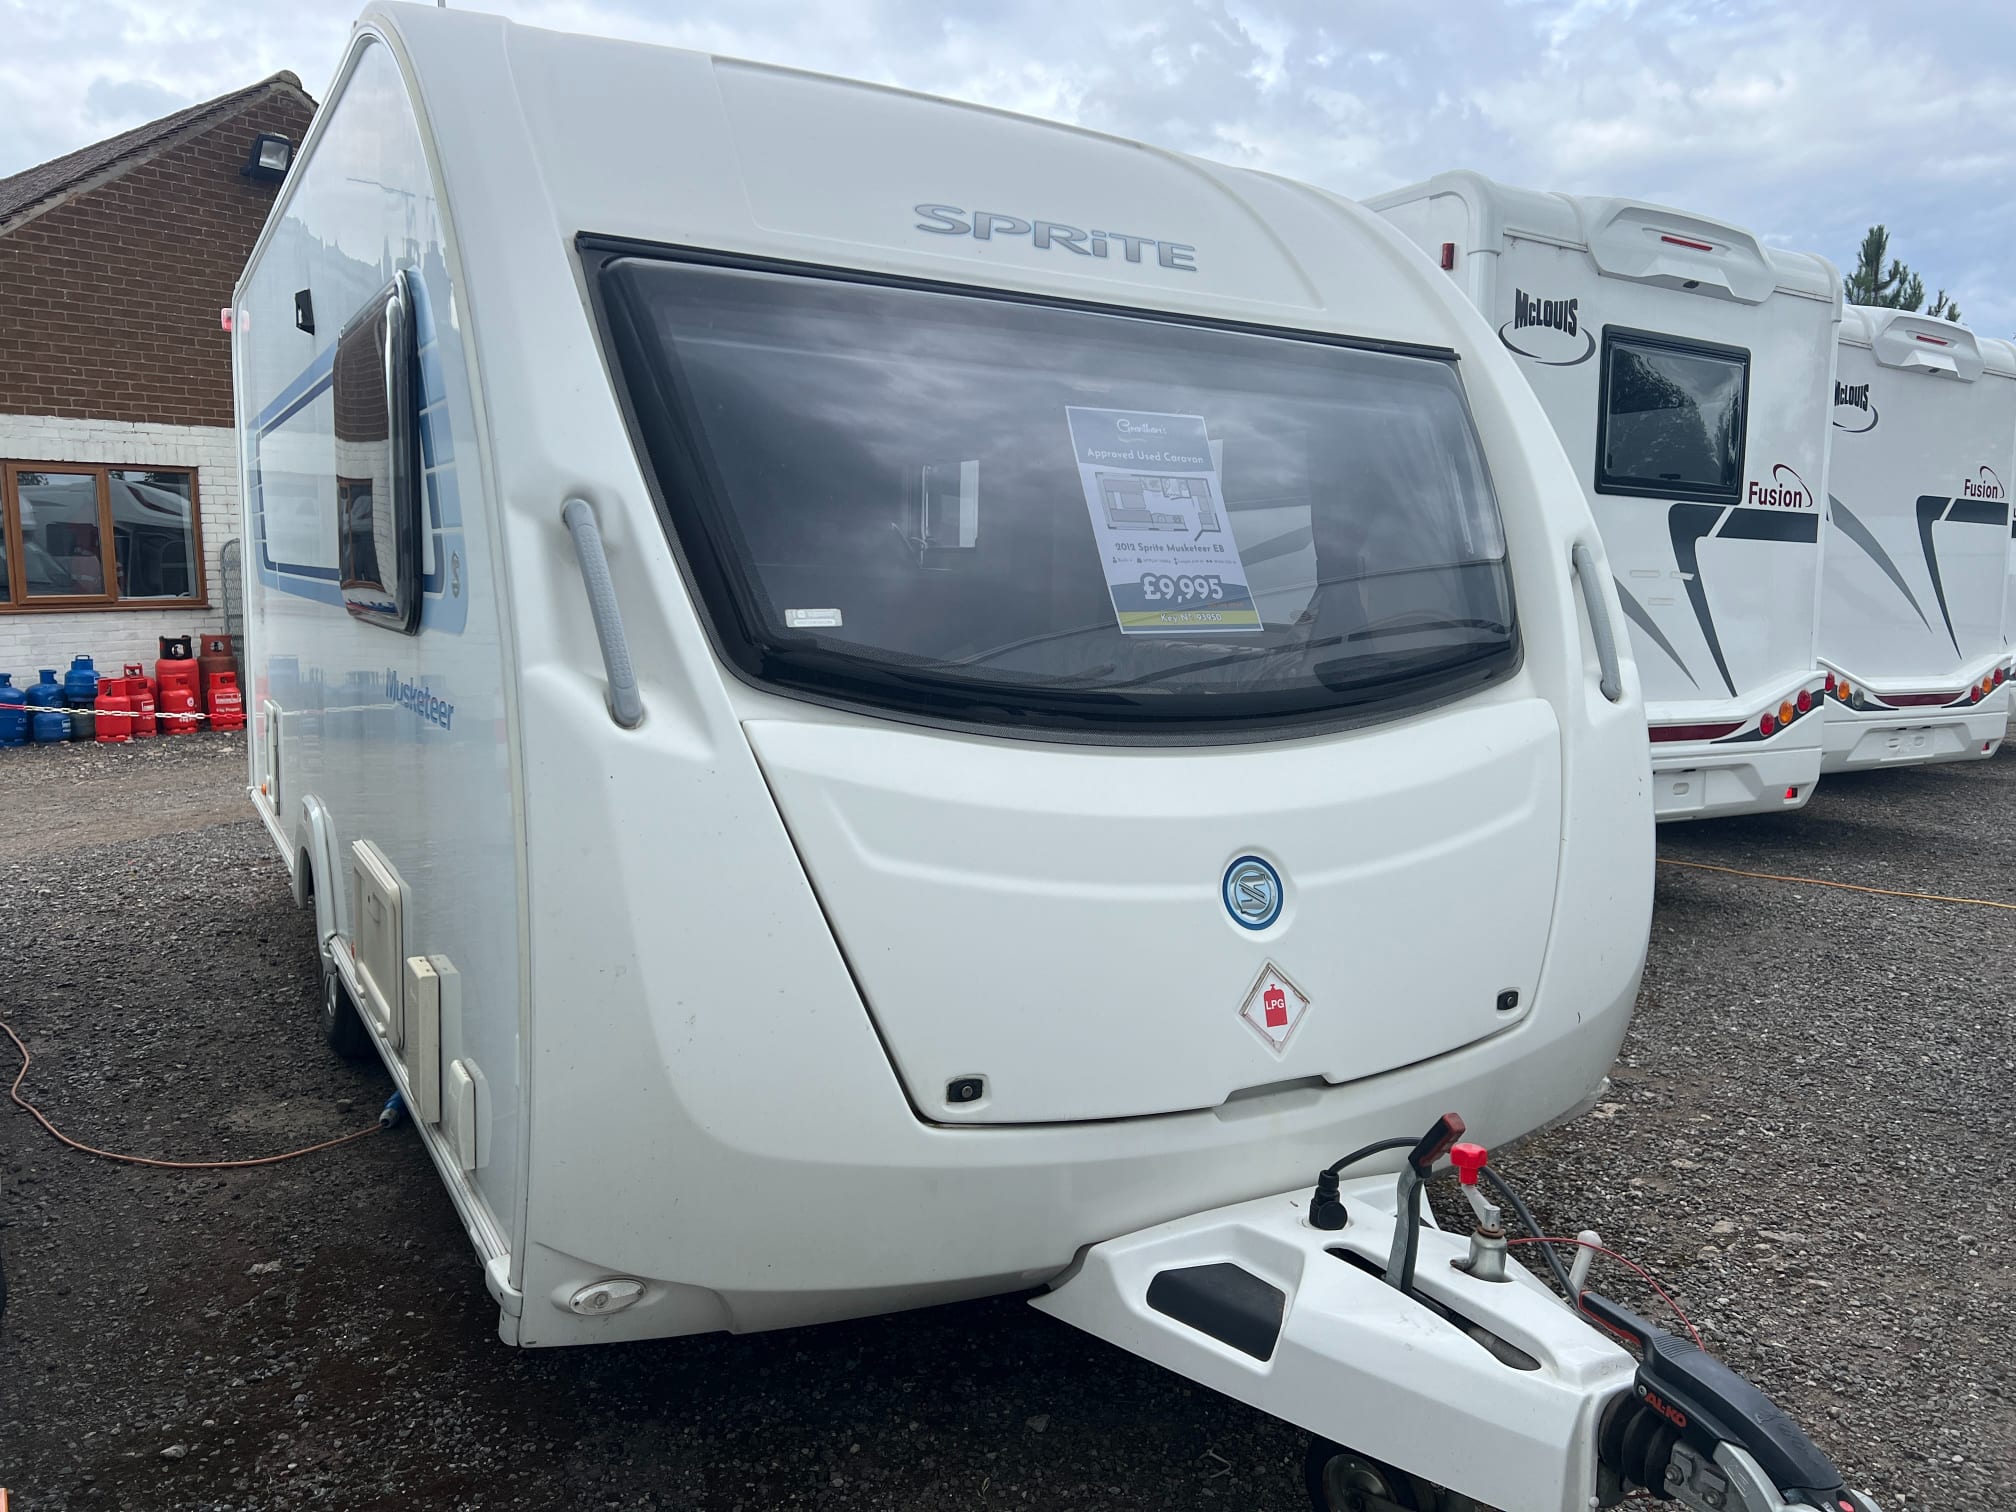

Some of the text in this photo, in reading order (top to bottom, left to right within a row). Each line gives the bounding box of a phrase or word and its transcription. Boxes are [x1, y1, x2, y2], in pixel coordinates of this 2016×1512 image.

[1087, 447, 1204, 464] Approved Used Caravan
[1749, 481, 1802, 508] Fusion
[1964, 479, 1998, 499] Fusion
[1115, 542, 1136, 551] 2012
[1137, 542, 1164, 553] Sprite
[1166, 543, 1211, 553] Musketeer
[1143, 576, 1224, 603] £9,995
[1160, 613, 1177, 623] Key
[386, 667, 454, 731] Musketeer
[1266, 999, 1285, 1010] LPG
